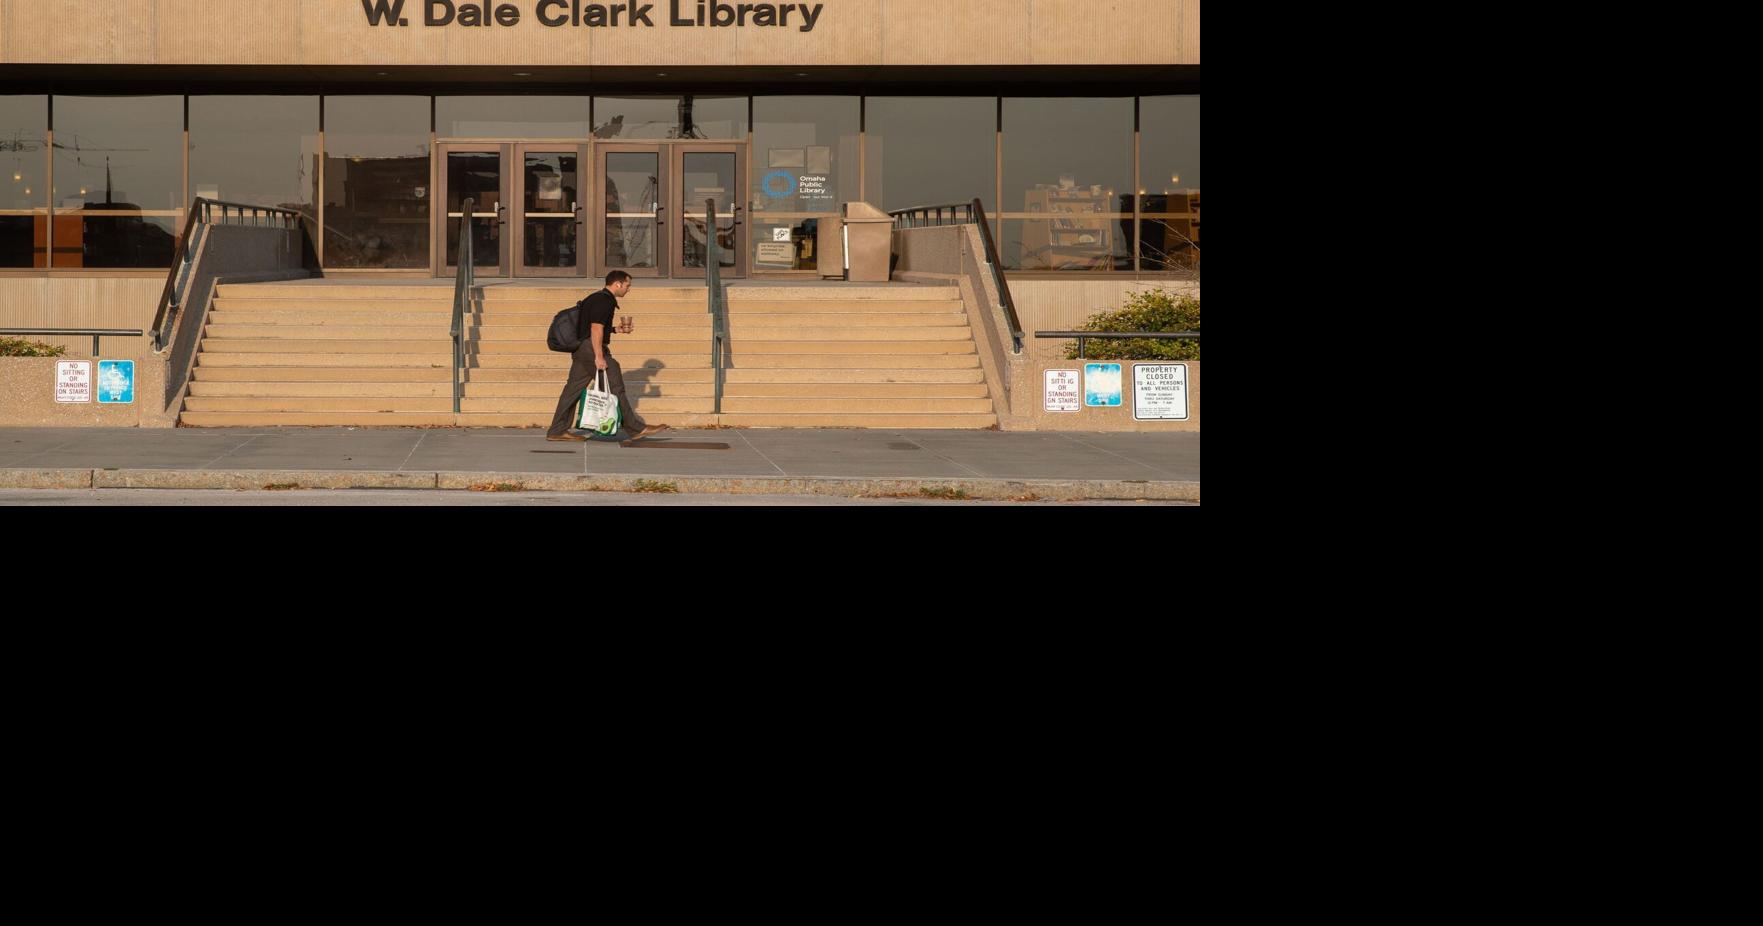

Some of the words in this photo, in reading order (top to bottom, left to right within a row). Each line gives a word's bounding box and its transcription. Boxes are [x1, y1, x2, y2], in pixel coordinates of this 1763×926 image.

[361, 0, 409, 26] W.
[424, 0, 521, 27] Dale
[535, 0, 655, 27] Clark
[670, 0, 823, 32] Library
